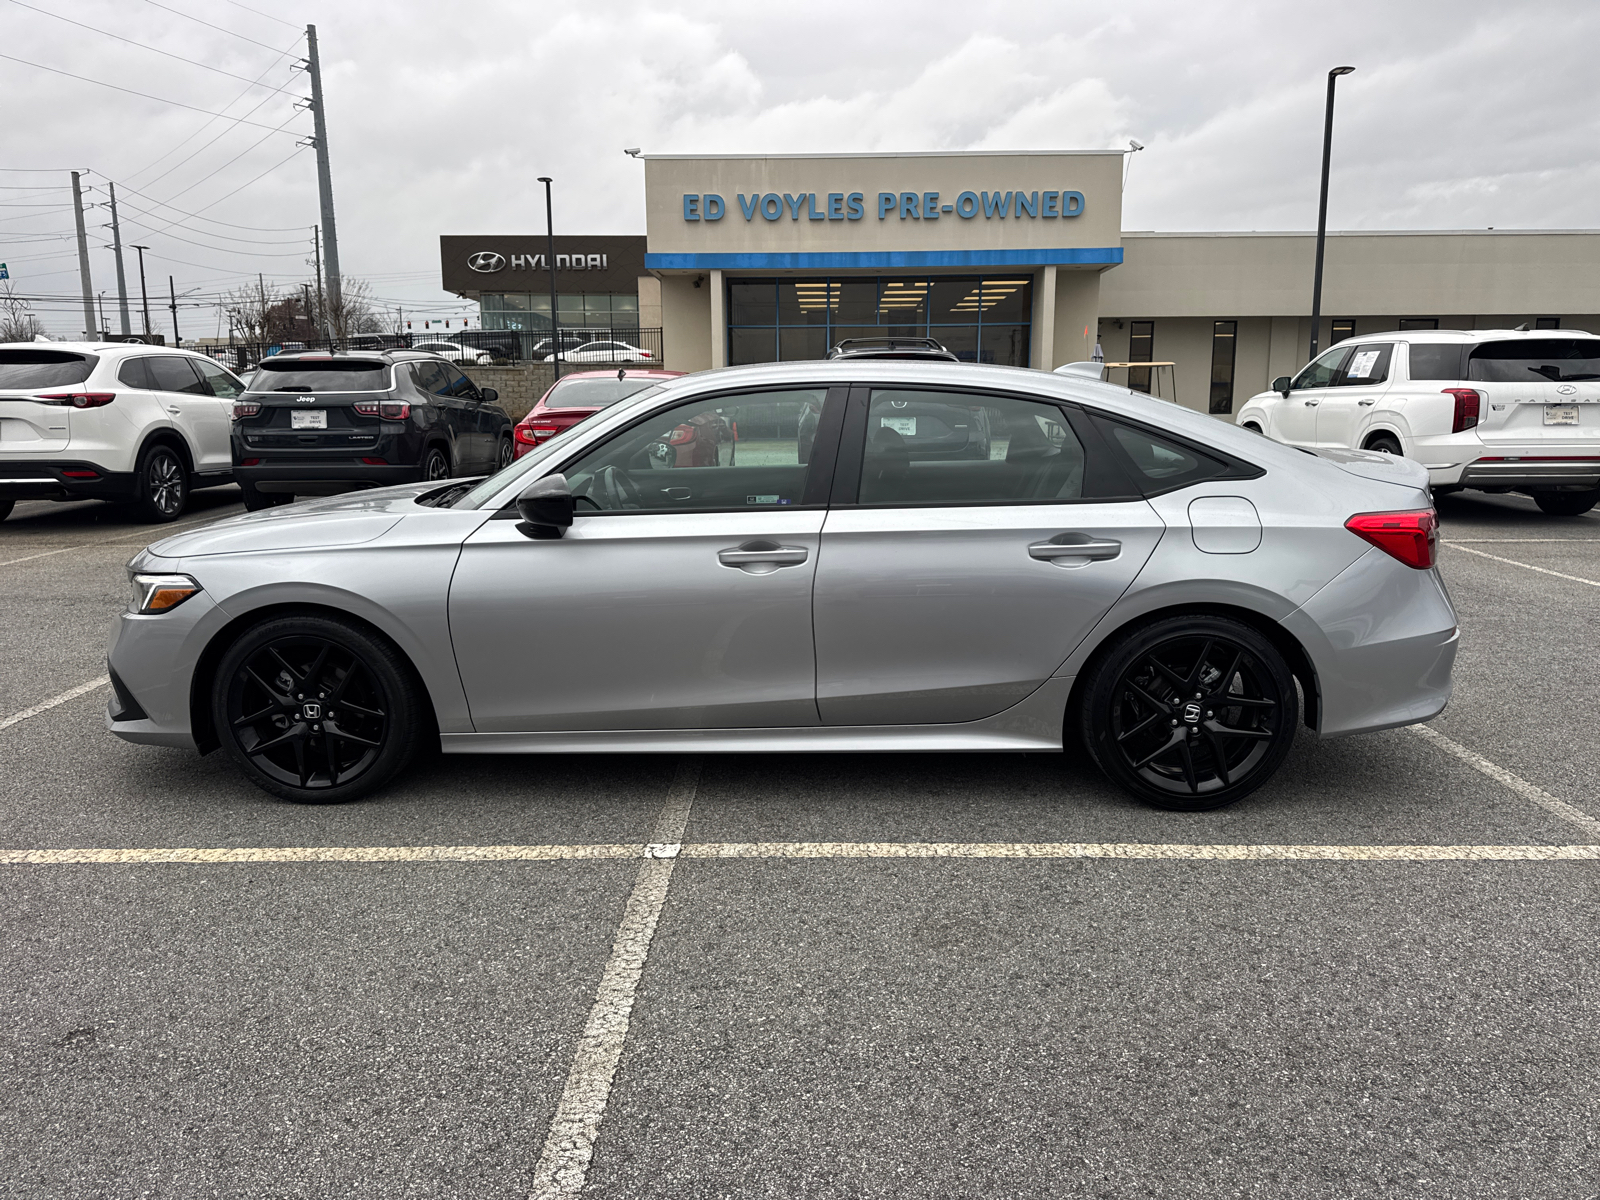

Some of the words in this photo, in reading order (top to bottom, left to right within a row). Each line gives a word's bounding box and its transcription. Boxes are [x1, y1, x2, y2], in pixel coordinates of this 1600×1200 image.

[683, 194, 725, 220] ED
[737, 193, 865, 220] VOYLES
[878, 190, 1086, 219] PRE-OWNED
[511, 254, 608, 270] HYUNDAI
